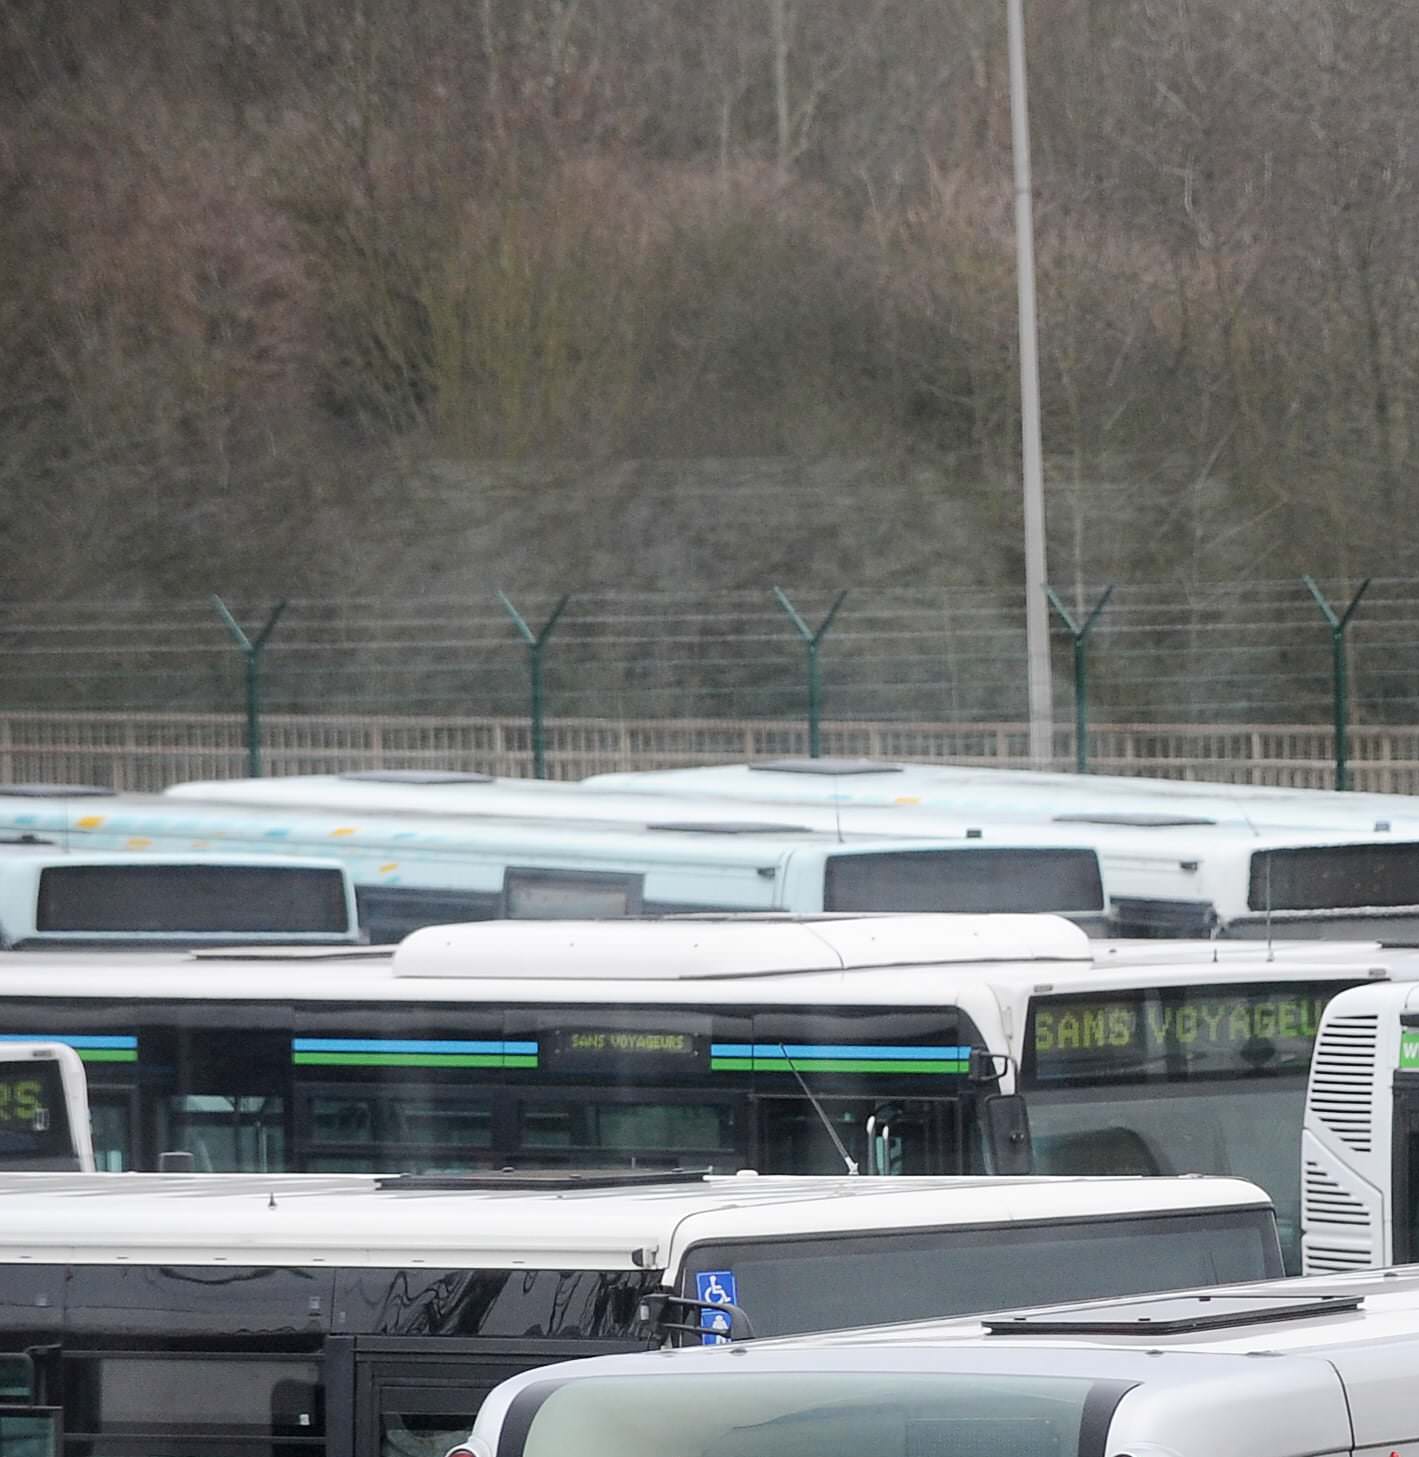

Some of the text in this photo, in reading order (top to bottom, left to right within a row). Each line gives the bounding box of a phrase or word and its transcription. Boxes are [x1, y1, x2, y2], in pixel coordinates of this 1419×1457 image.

[571, 1033, 684, 1049] SANS VOYAGEURS
[1035, 999, 1322, 1050] SANS VOYAGEU
